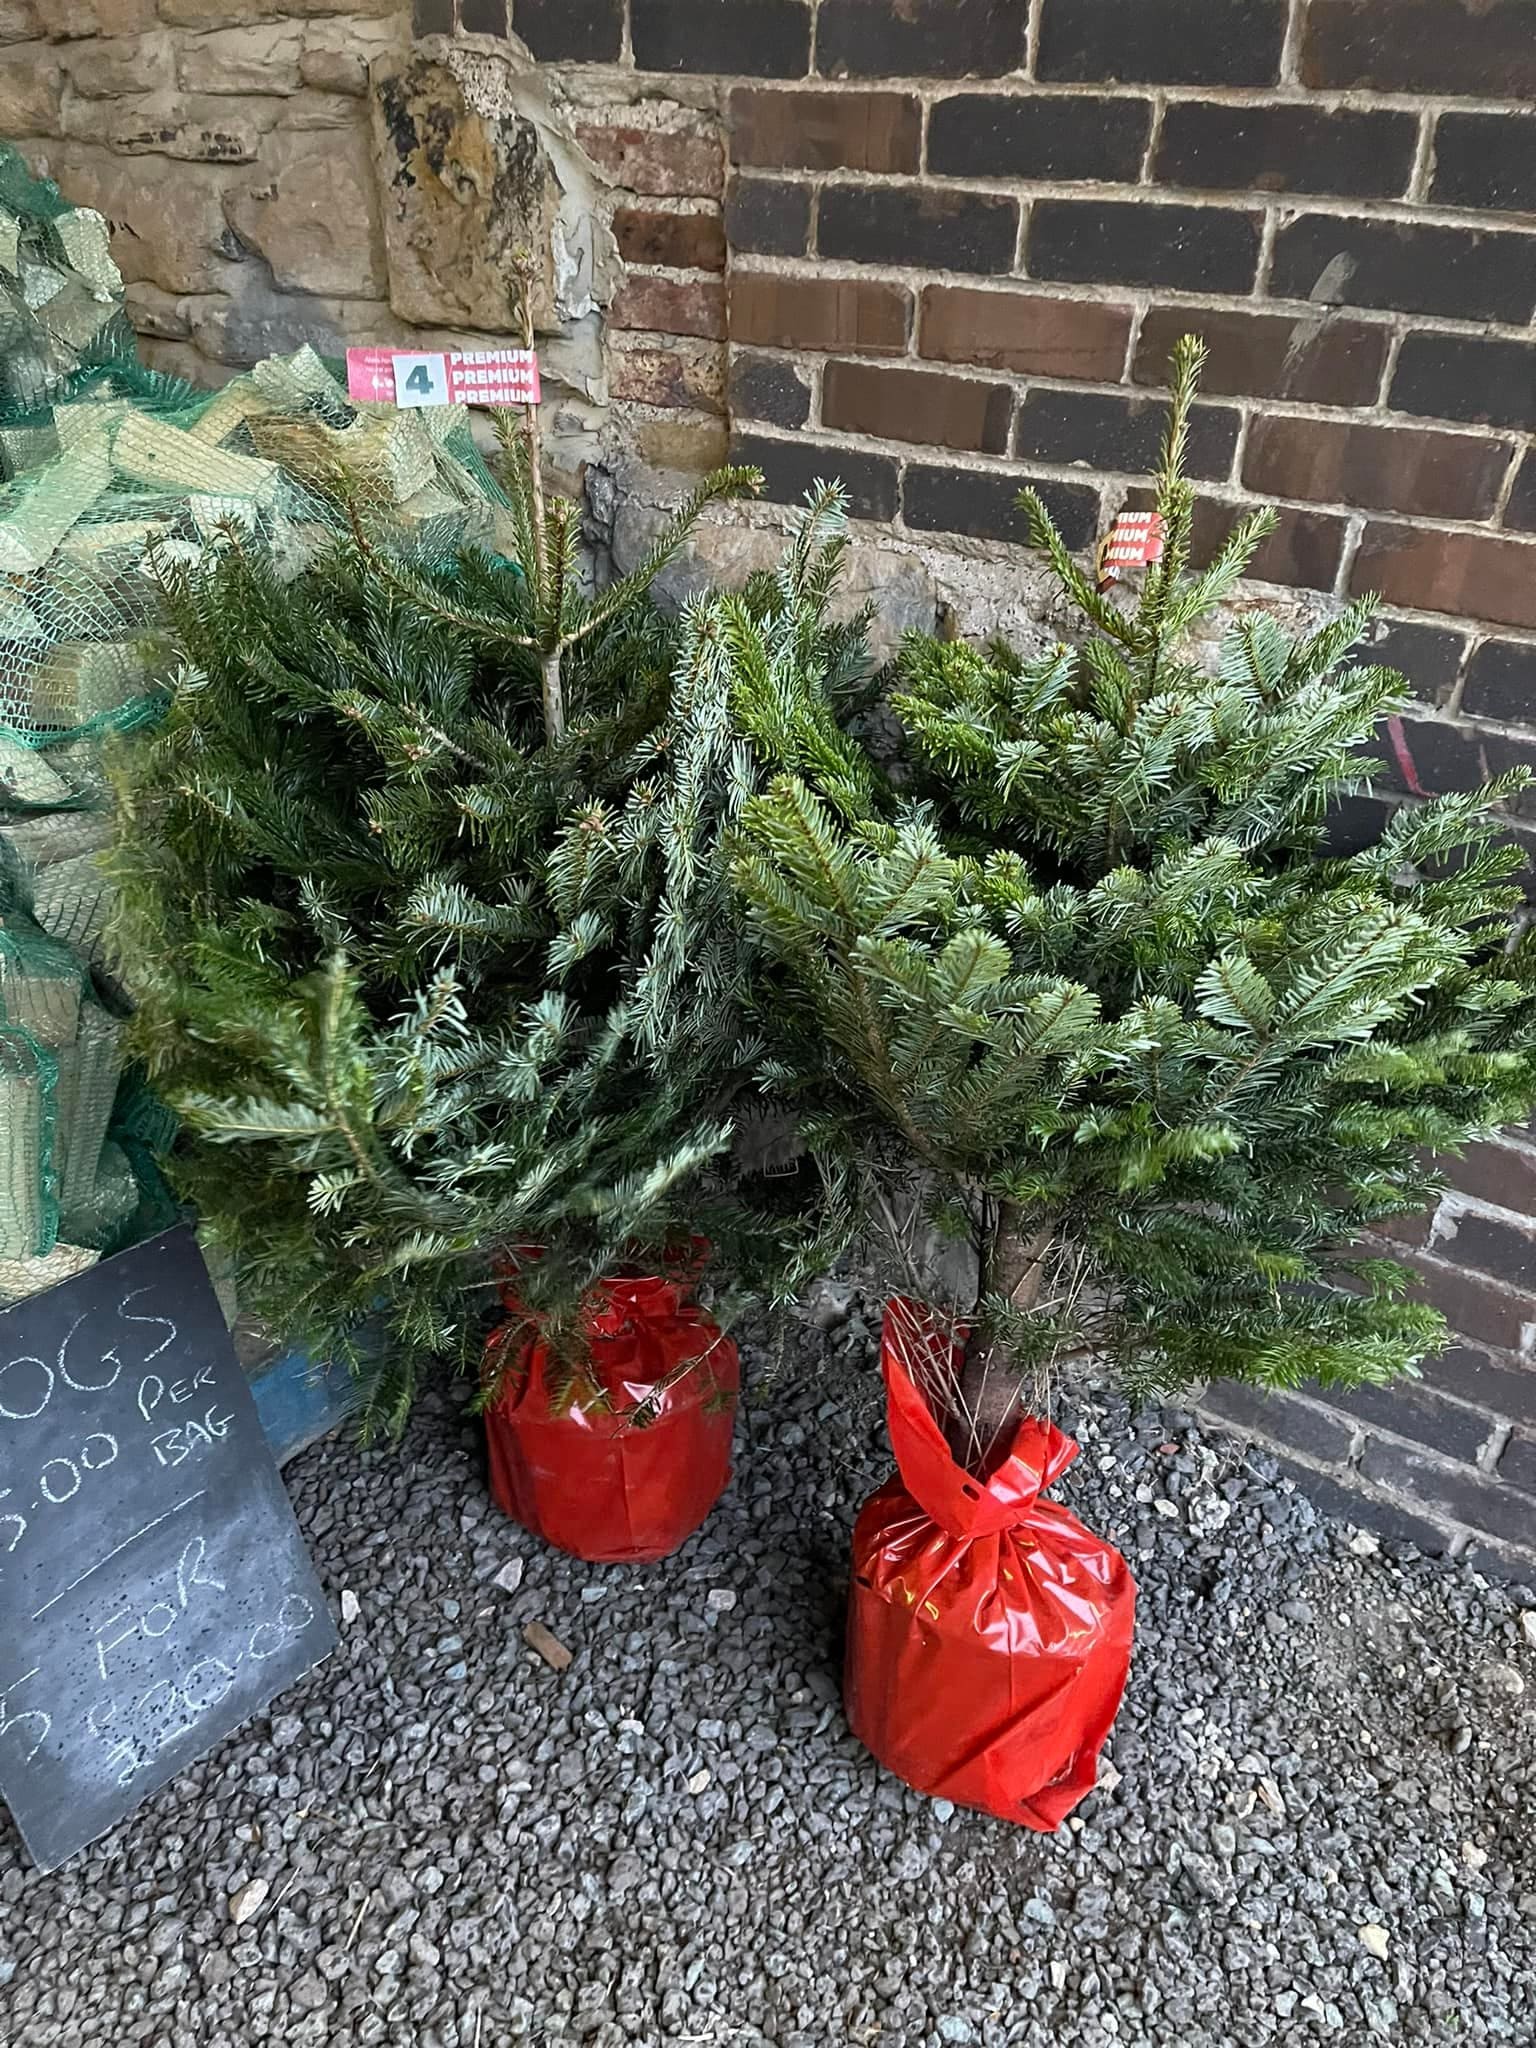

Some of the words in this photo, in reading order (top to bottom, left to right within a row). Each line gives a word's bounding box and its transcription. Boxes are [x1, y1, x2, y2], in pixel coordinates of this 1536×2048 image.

[450, 350, 533, 365] PREMIUM
[405, 364, 434, 395] 4
[452, 368, 534, 385] PREMIUM
[454, 388, 535, 404] PREMIUM
[137, 1364, 217, 1422] PER
[150, 1403, 236, 1466] BAG
[93, 1535, 227, 1681] FOR
